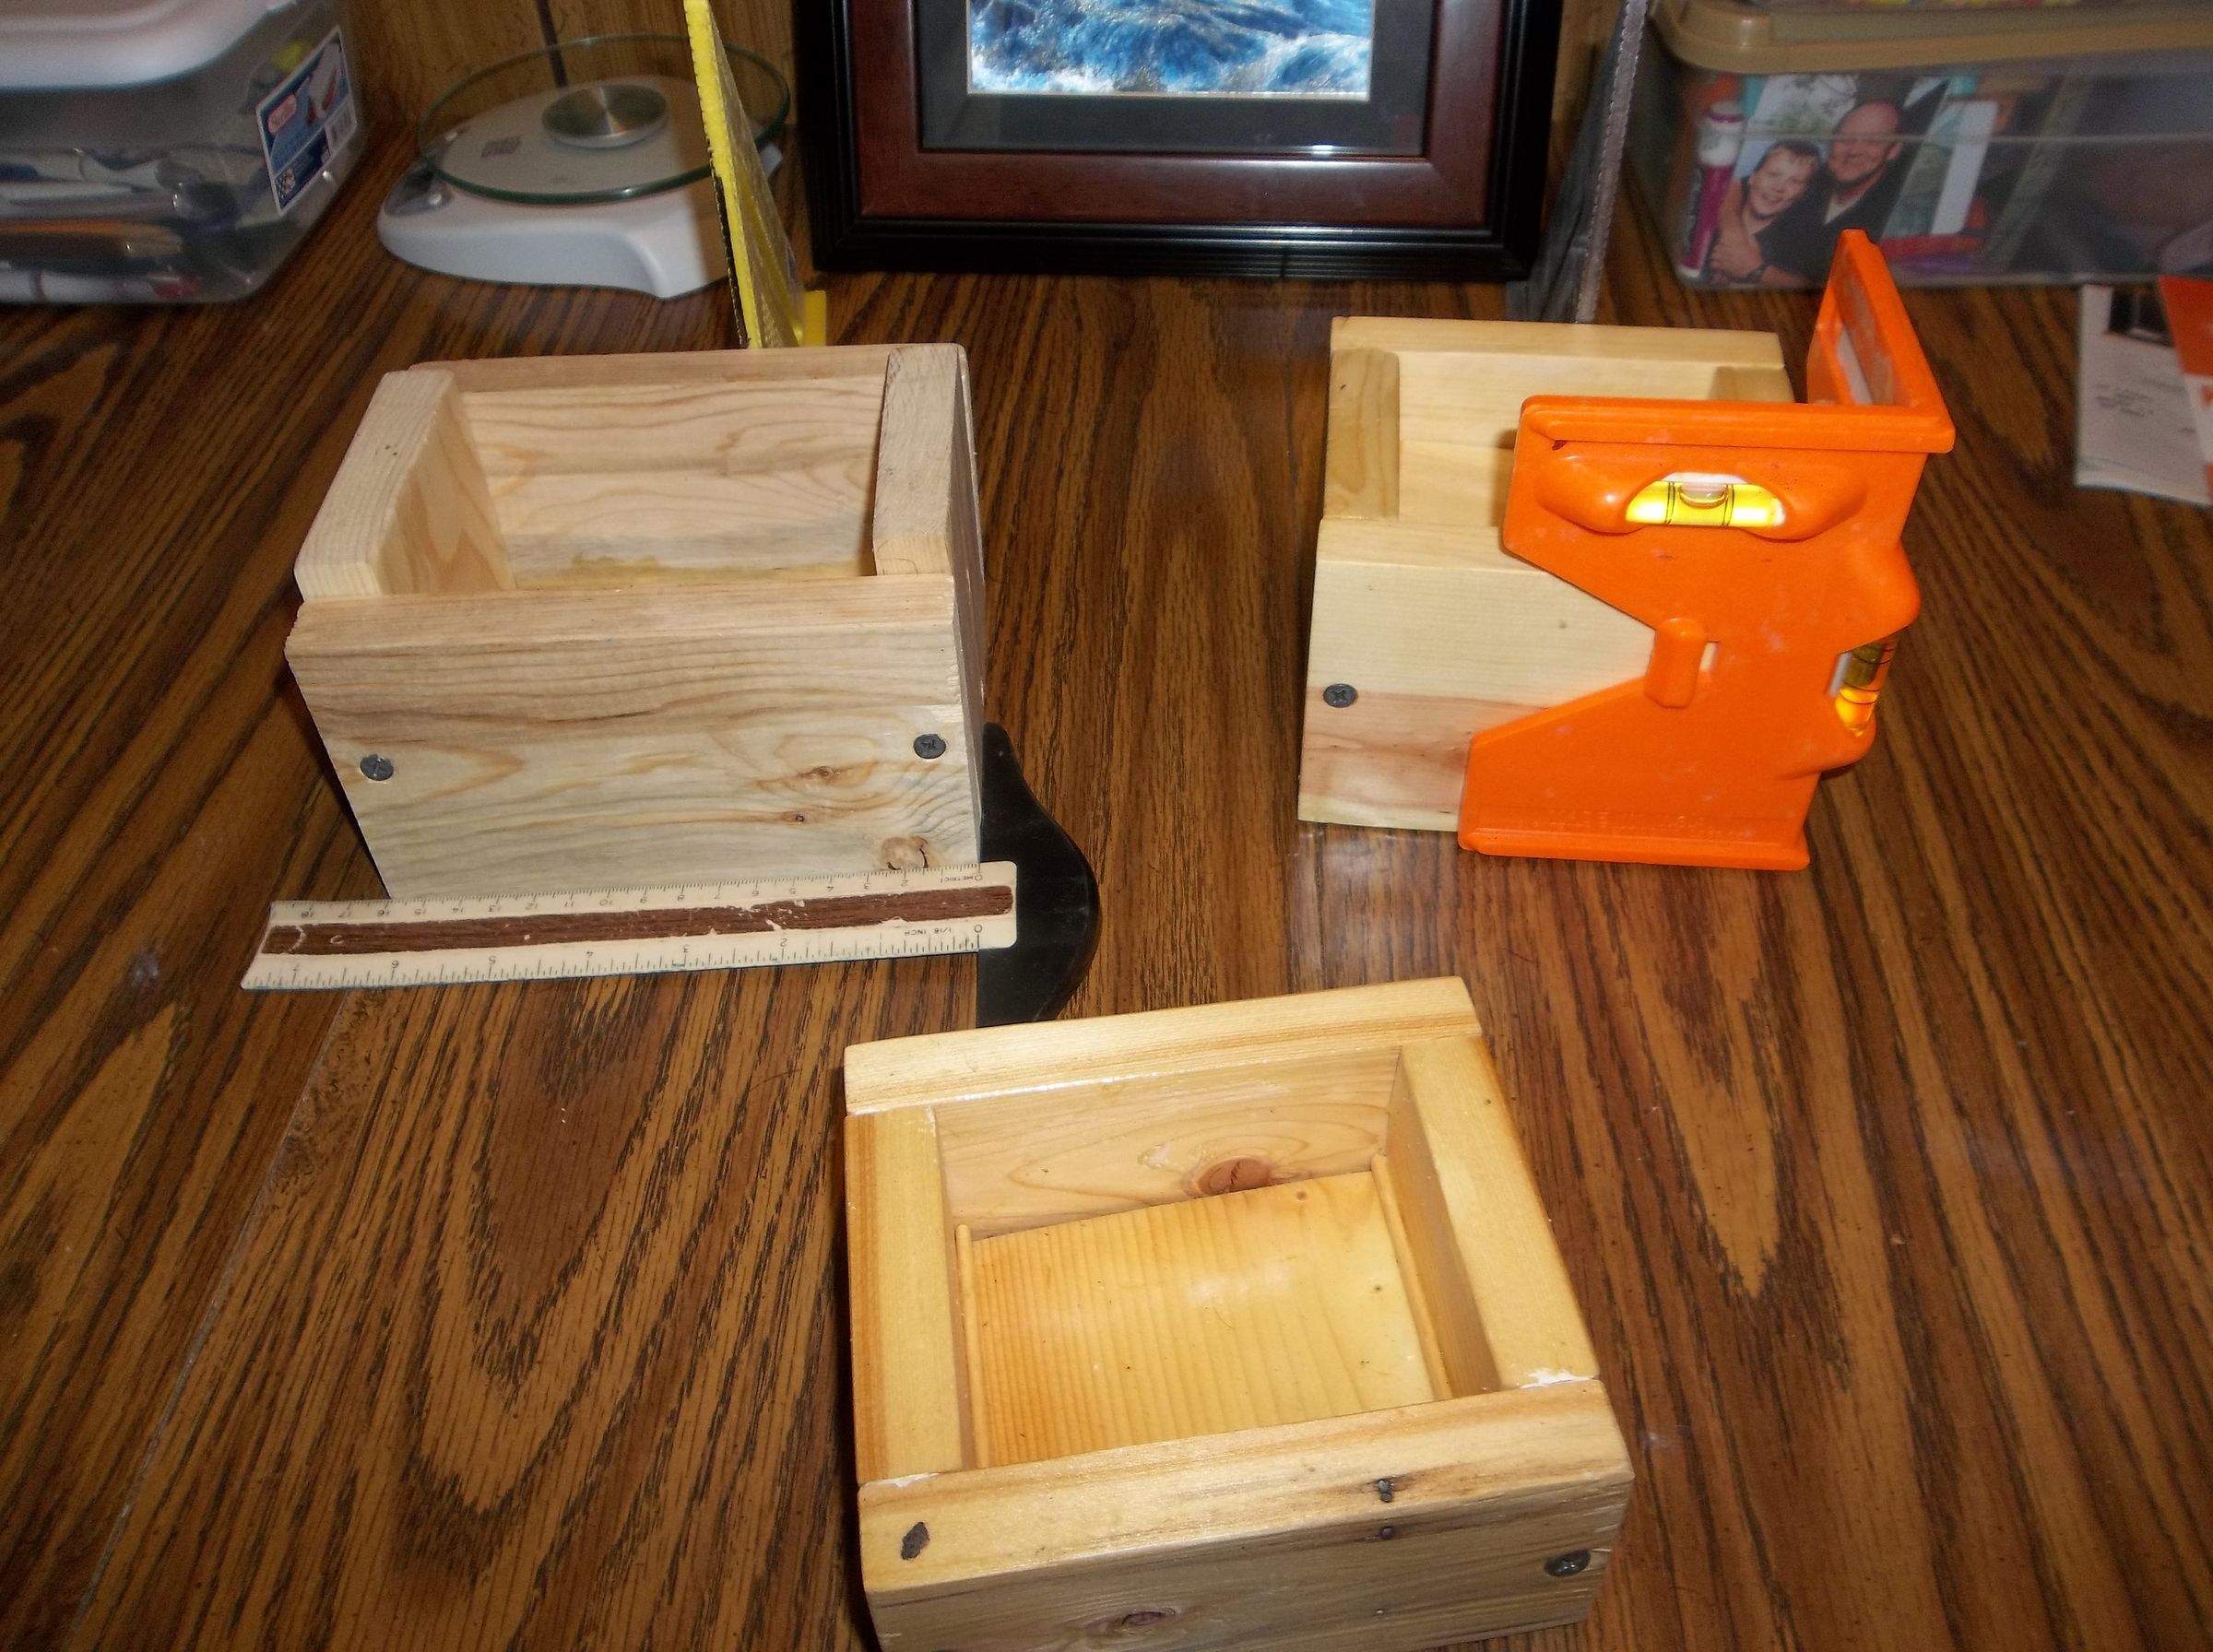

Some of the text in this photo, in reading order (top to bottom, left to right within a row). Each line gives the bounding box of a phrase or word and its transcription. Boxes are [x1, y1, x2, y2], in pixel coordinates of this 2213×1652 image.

[779, 938, 788, 947] 2
[682, 944, 690, 953] 3
[391, 960, 399, 969] 6
[488, 956, 496, 964] 5
